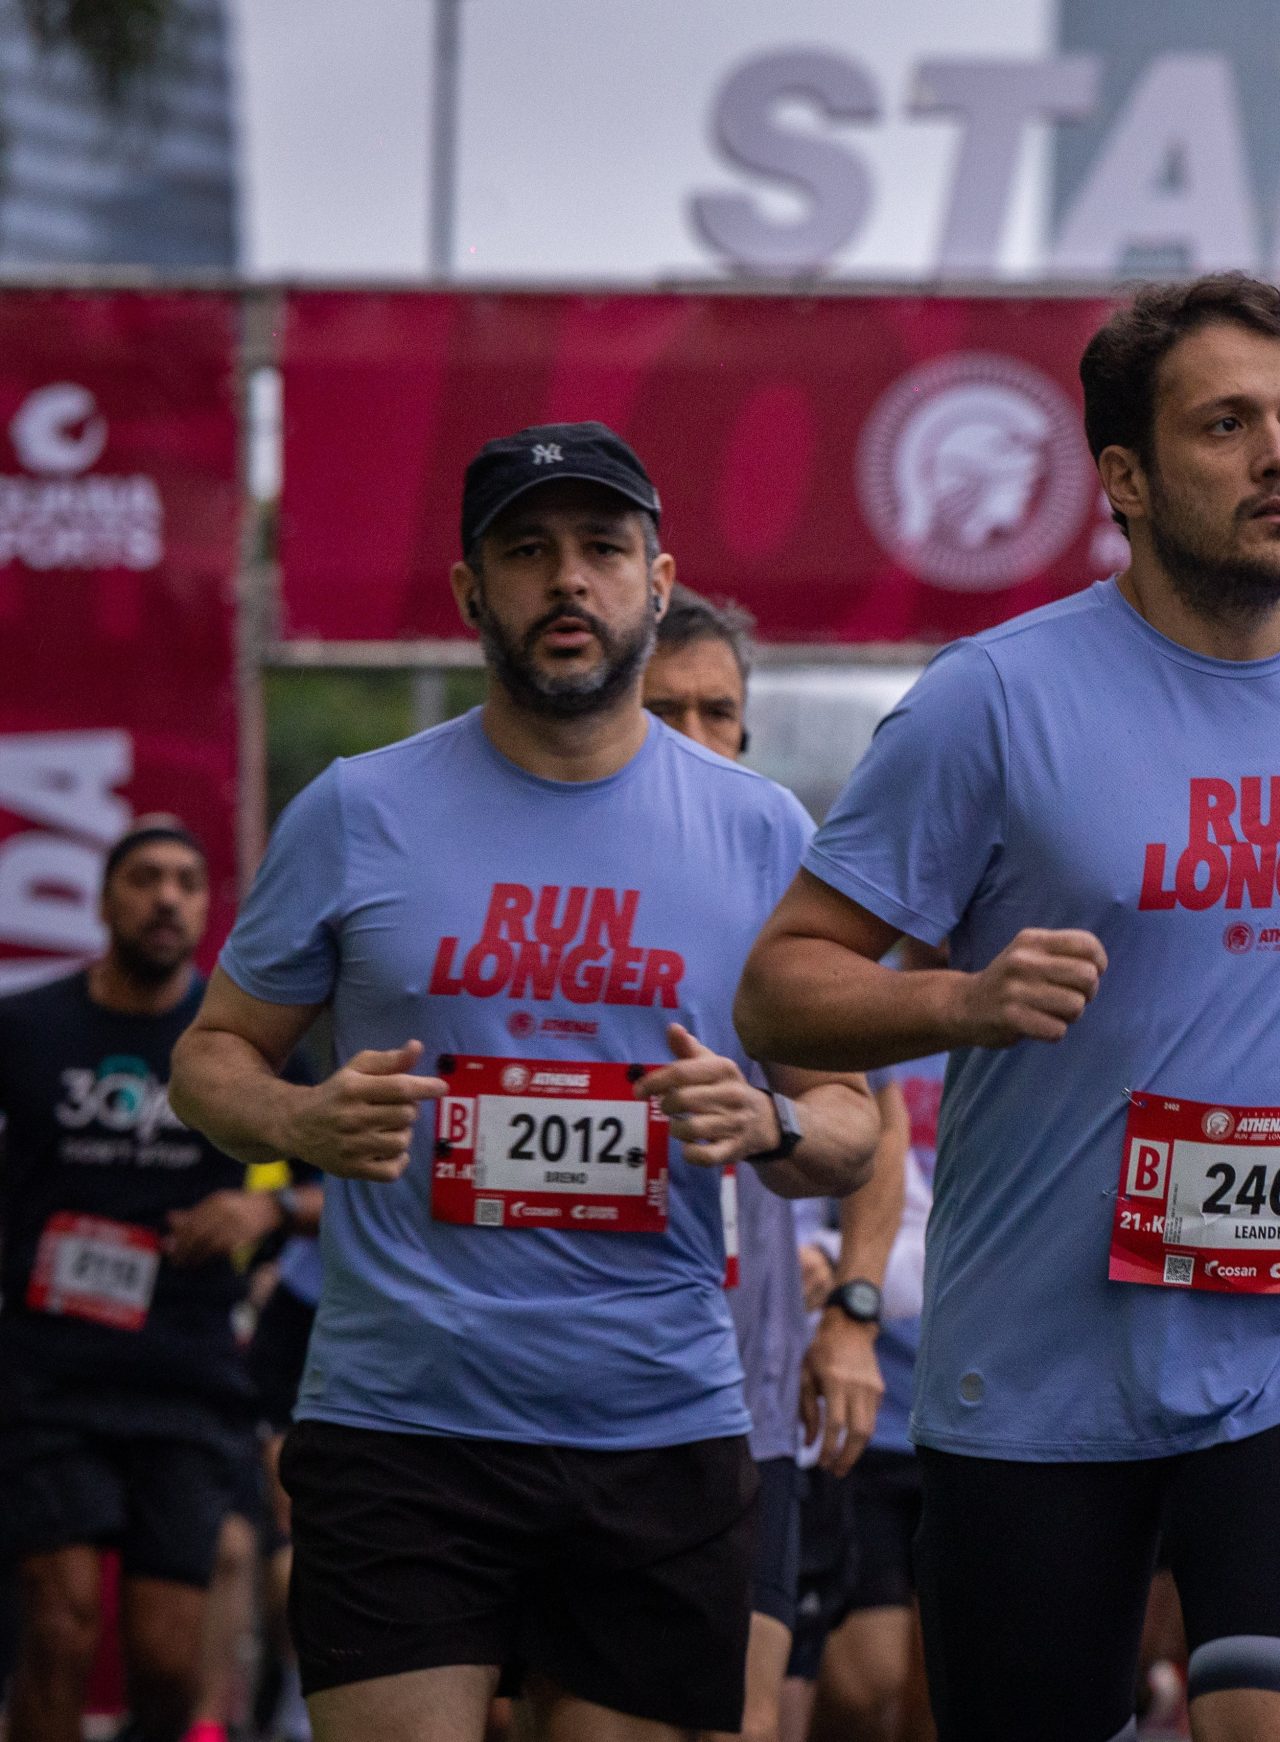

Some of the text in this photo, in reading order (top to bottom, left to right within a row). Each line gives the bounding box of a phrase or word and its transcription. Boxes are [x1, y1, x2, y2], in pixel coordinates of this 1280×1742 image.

[0, 726, 134, 992] DA
[479, 882, 641, 949] RUN
[428, 936, 686, 1008] LONGER
[449, 1101, 468, 1144] B
[507, 1112, 625, 1165] 2012
[1134, 1144, 1161, 1191] B
[1217, 1265, 1257, 1277] cosan
